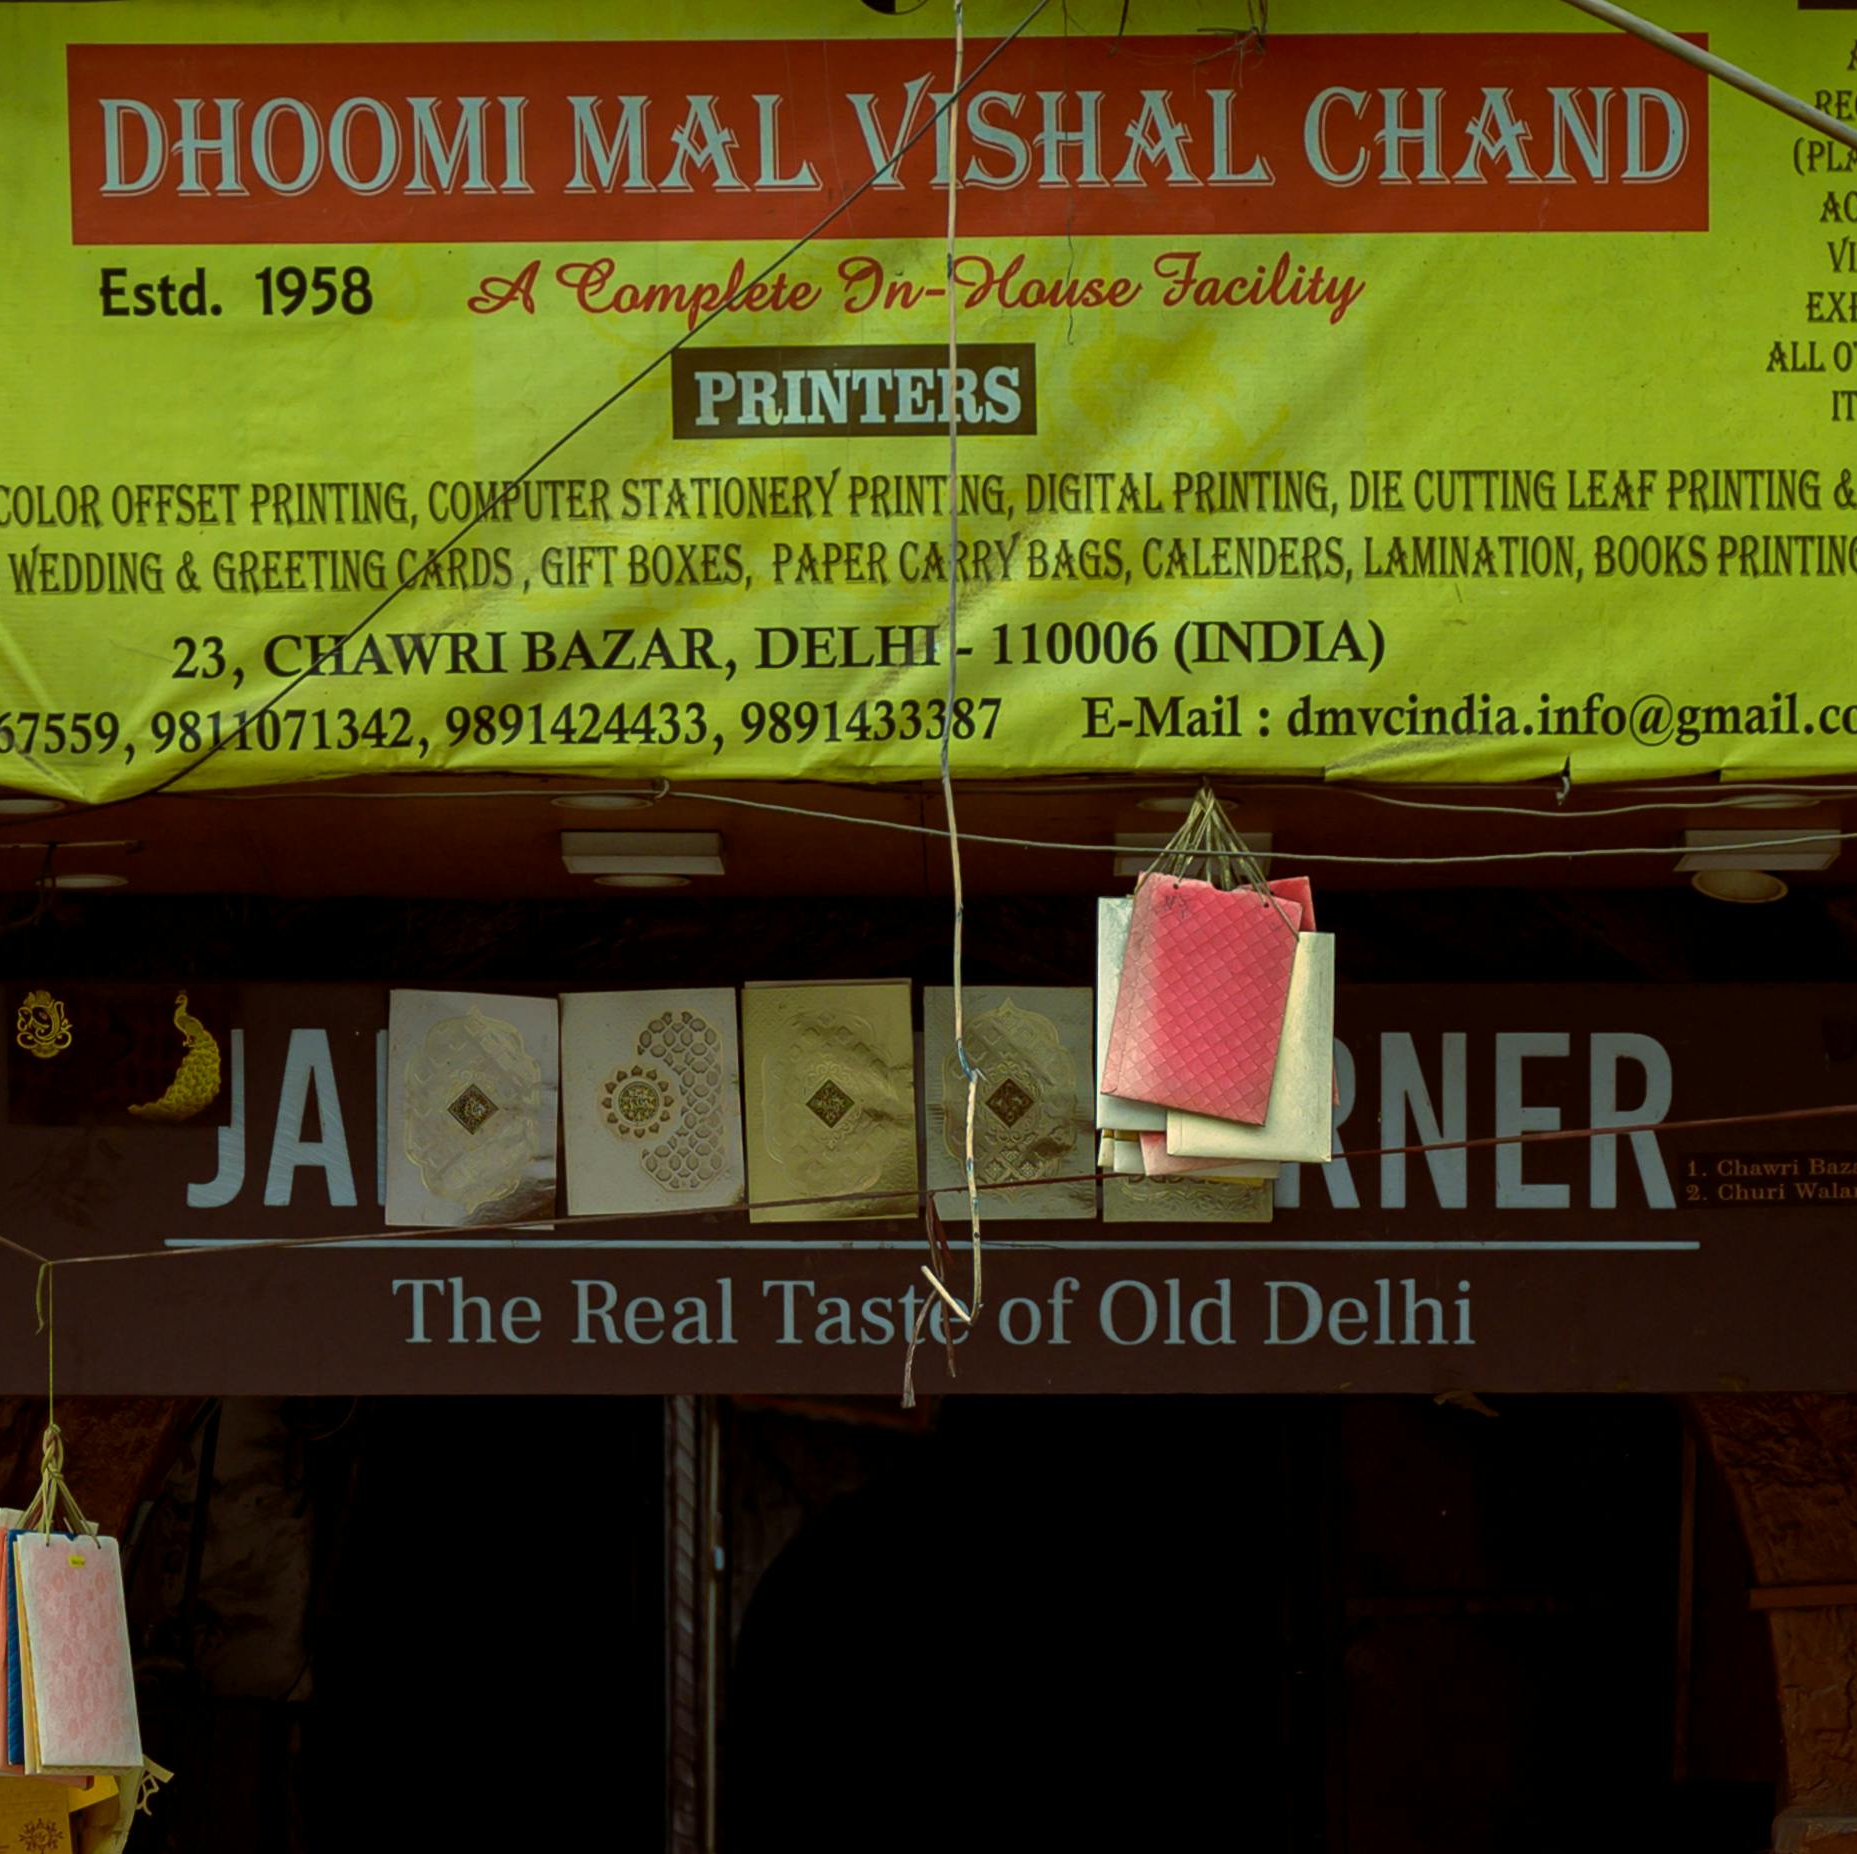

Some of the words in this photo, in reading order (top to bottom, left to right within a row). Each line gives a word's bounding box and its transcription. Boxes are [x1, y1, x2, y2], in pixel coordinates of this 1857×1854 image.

[97, 96, 536, 198] DHOOMI
[563, 93, 823, 195] MAL
[846, 72, 1276, 193] VISHAL
[1303, 84, 1692, 189] CHAND
[98, 266, 224, 318] Estd.
[254, 265, 375, 316] 1958
[467, 258, 542, 315] A
[555, 257, 823, 332] Complete
[838, 255, 1143, 314] In-House
[1152, 251, 1367, 325] Facility
[1765, 341, 1826, 375] ALL
[693, 364, 1023, 429] PRINTERS
[110, 482, 242, 528] OFFSET
[249, 480, 420, 531] PRINTING,
[428, 475, 617, 524] COMPUTER
[619, 465, 842, 521] STATIONERY
[847, 472, 1017, 523] PRINTNG,
[1024, 469, 1161, 516] DIGITAL
[1171, 469, 1340, 519] PRINTING,
[1348, 468, 1407, 513] DIE
[1413, 468, 1557, 513] CUTTING
[1566, 467, 1660, 512] LEAF
[1665, 467, 1823, 513] PRINTING
[8, 543, 165, 597] WEDDING
[175, 550, 204, 592] &
[211, 548, 387, 595] GREETING
[541, 543, 619, 588] GIFT
[626, 541, 754, 590] BOXES,
[772, 540, 888, 586] PAPER
[898, 531, 1020, 585] CARRY
[1025, 535, 1134, 587] BAGS,
[1142, 534, 1354, 585] CALENDERS,
[1363, 534, 1585, 585] LAMINATION,
[1593, 534, 1709, 578] BOOKS
[170, 635, 246, 691] 23,
[263, 628, 509, 679] CHAWRI
[520, 627, 738, 682] BAZAR,
[753, 624, 941, 670] DELHI
[992, 619, 1160, 667] 110006
[1173, 617, 1387, 674] (INDIA)
[150, 705, 430, 763] 9811071342,
[444, 702, 726, 756] 9891424433,
[740, 696, 1002, 745] 9891433387
[1080, 692, 1242, 742] E-Mail
[1716, 1158, 1801, 1177] Chawri
[1717, 1182, 1787, 1201] Churi
[391, 1277, 544, 1346] The
[570, 1276, 739, 1346] Real
[760, 1277, 970, 1347] Taste
[997, 1275, 1081, 1346] of
[1099, 1276, 1237, 1347] Old
[1261, 1276, 1477, 1346] Delhi
